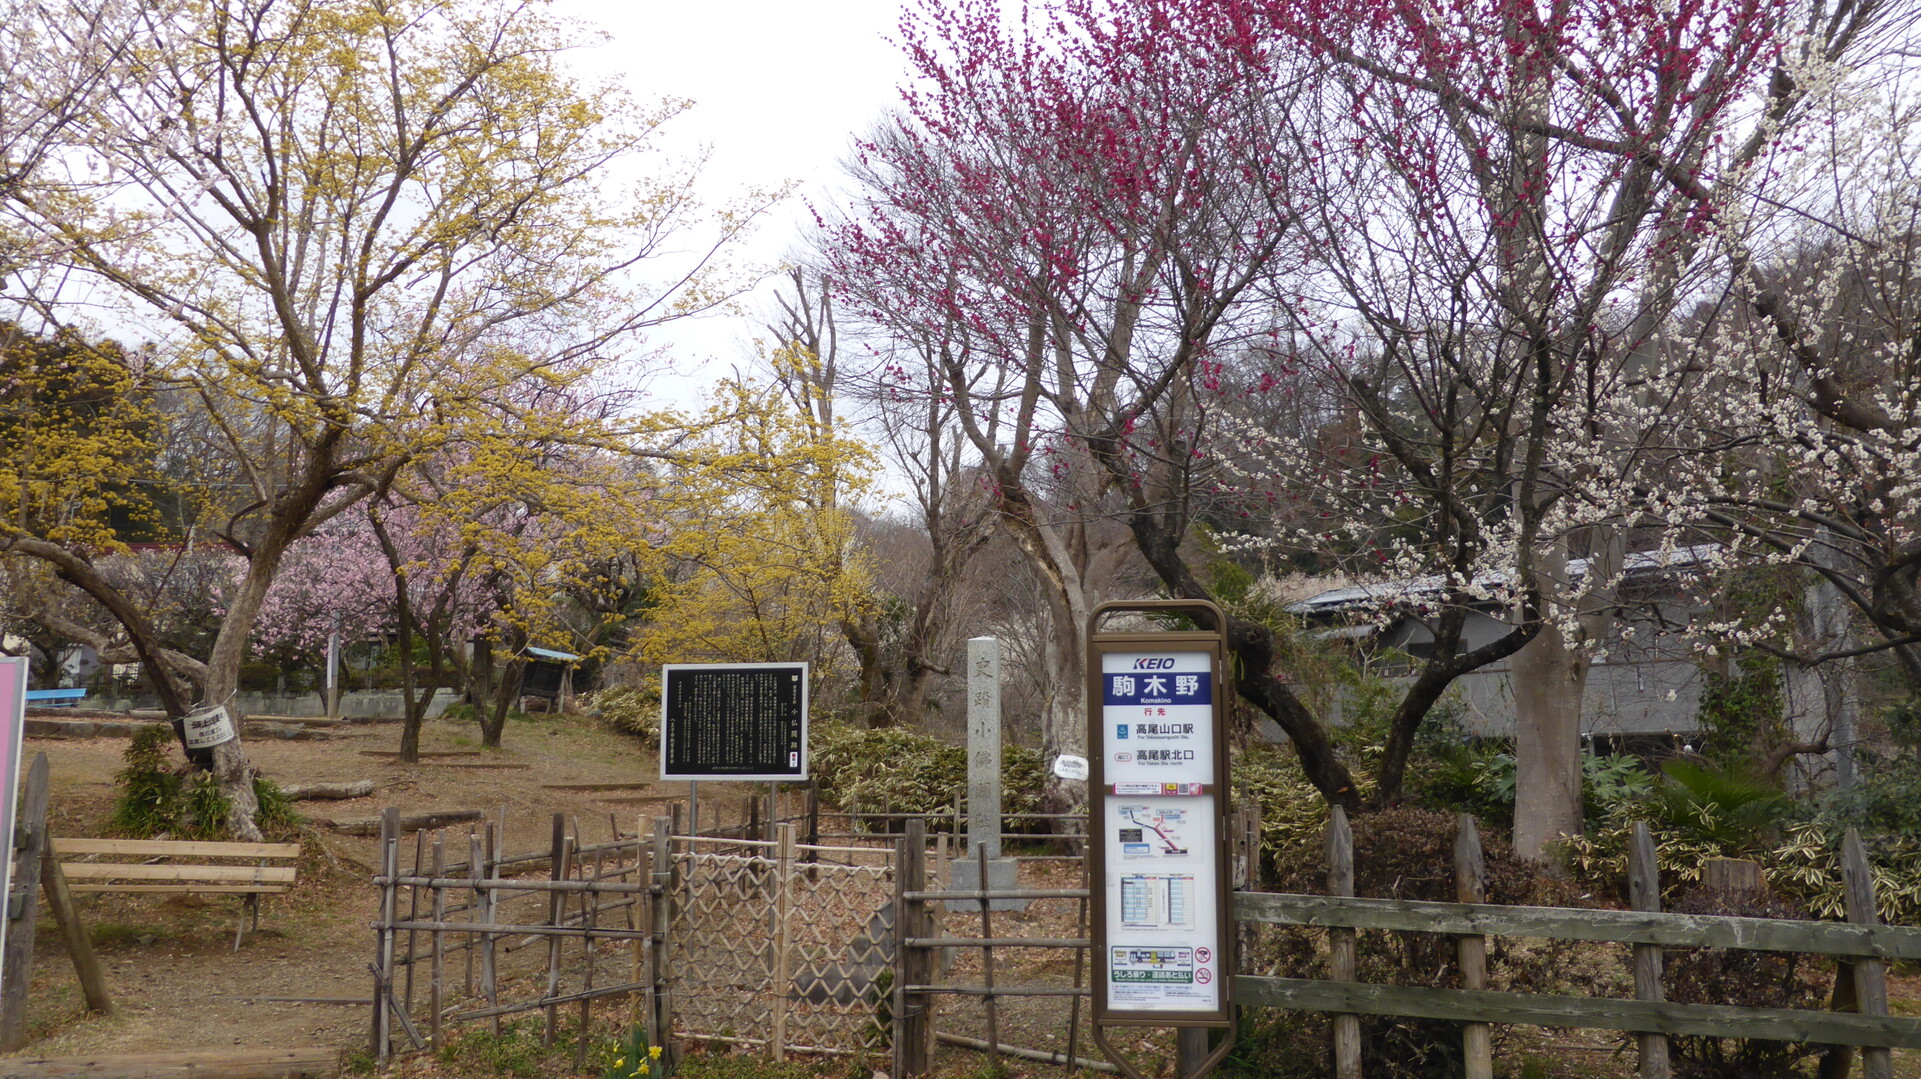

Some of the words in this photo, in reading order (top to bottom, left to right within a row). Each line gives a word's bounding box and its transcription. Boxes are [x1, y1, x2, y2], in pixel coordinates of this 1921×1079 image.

[1133, 658, 1175, 670] KEIO
[1112, 675, 1199, 696] 駒木野
[1144, 708, 1166, 716] 行先
[1136, 723, 1194, 735] 高尾山口駅
[1136, 750, 1194, 761] 高尾駅北口
